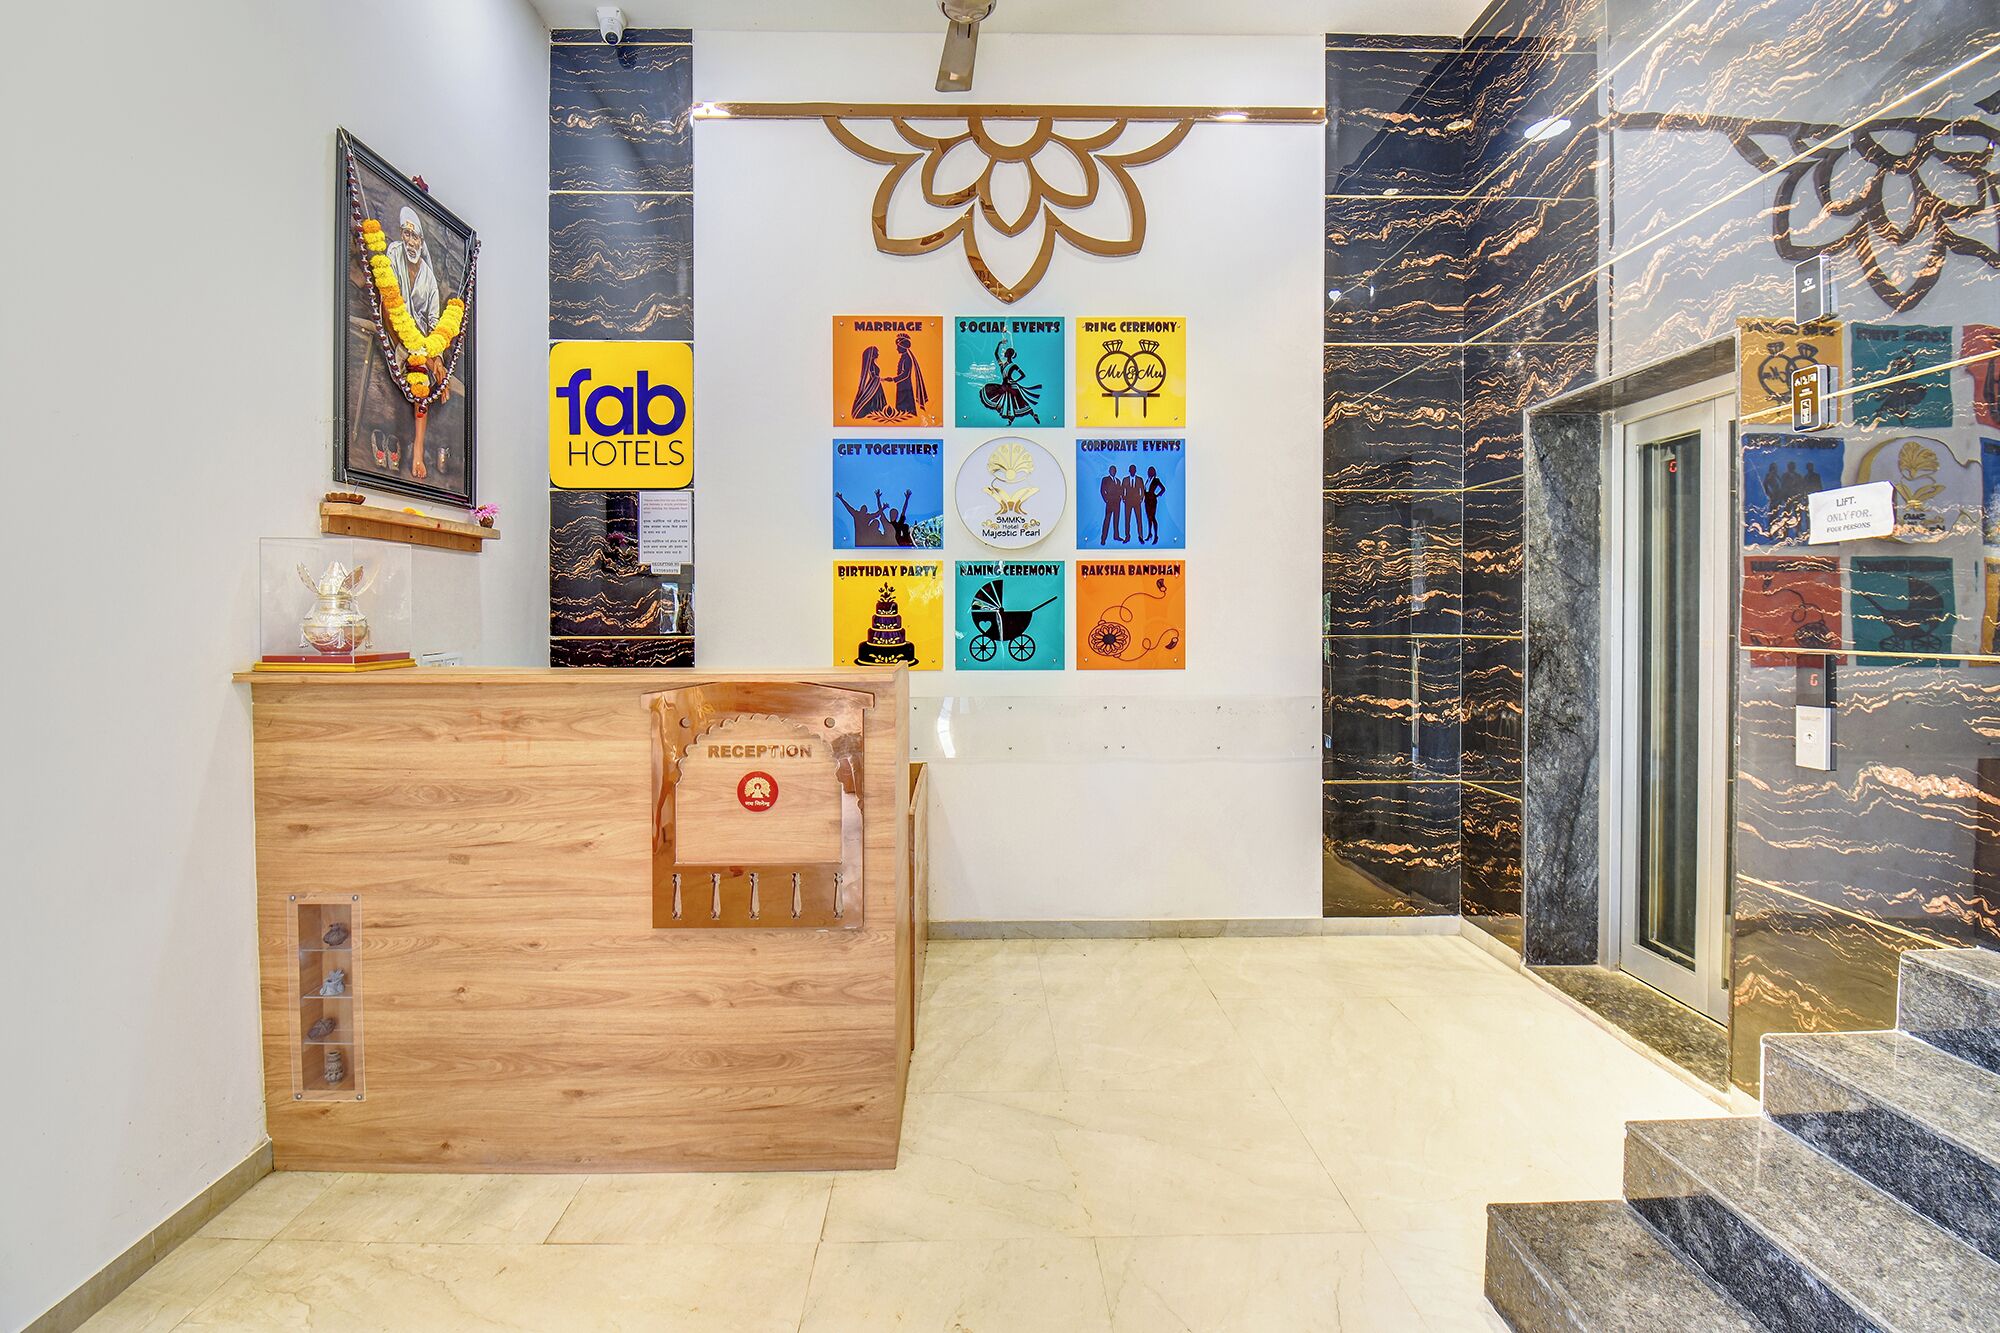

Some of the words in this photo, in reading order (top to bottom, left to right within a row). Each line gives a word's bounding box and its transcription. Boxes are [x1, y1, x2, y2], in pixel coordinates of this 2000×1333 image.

[854, 321, 922, 332] MARRIAGE
[959, 321, 1006, 333] SOCIAL
[1012, 321, 1060, 333] EVENTS
[1085, 321, 1117, 333] RING
[1120, 321, 1177, 333] CEREMONY
[555, 368, 686, 437] fab
[837, 443, 862, 455] GET
[865, 443, 938, 455] TOGETHERS
[1081, 440, 1138, 452] CORPORATE
[1142, 440, 1181, 452] EVENTS
[568, 439, 685, 467] HOTELS
[996, 516, 1026, 524] SMMK's
[1826, 511, 1848, 523] ONLY
[1826, 525, 1842, 533] FOUR
[1843, 521, 1871, 531] PERSONS
[982, 529, 1018, 539] Majestic
[1020, 529, 1041, 537] Pearl
[837, 565, 897, 577] BIRTHDAY
[900, 565, 938, 577] PARTY
[959, 564, 1001, 576] NAMING
[1003, 564, 1060, 576] CEREMONY
[1081, 564, 1126, 576] RAKSHA
[1128, 564, 1181, 576] BANDHAN
[707, 745, 812, 759] RECEPTION
